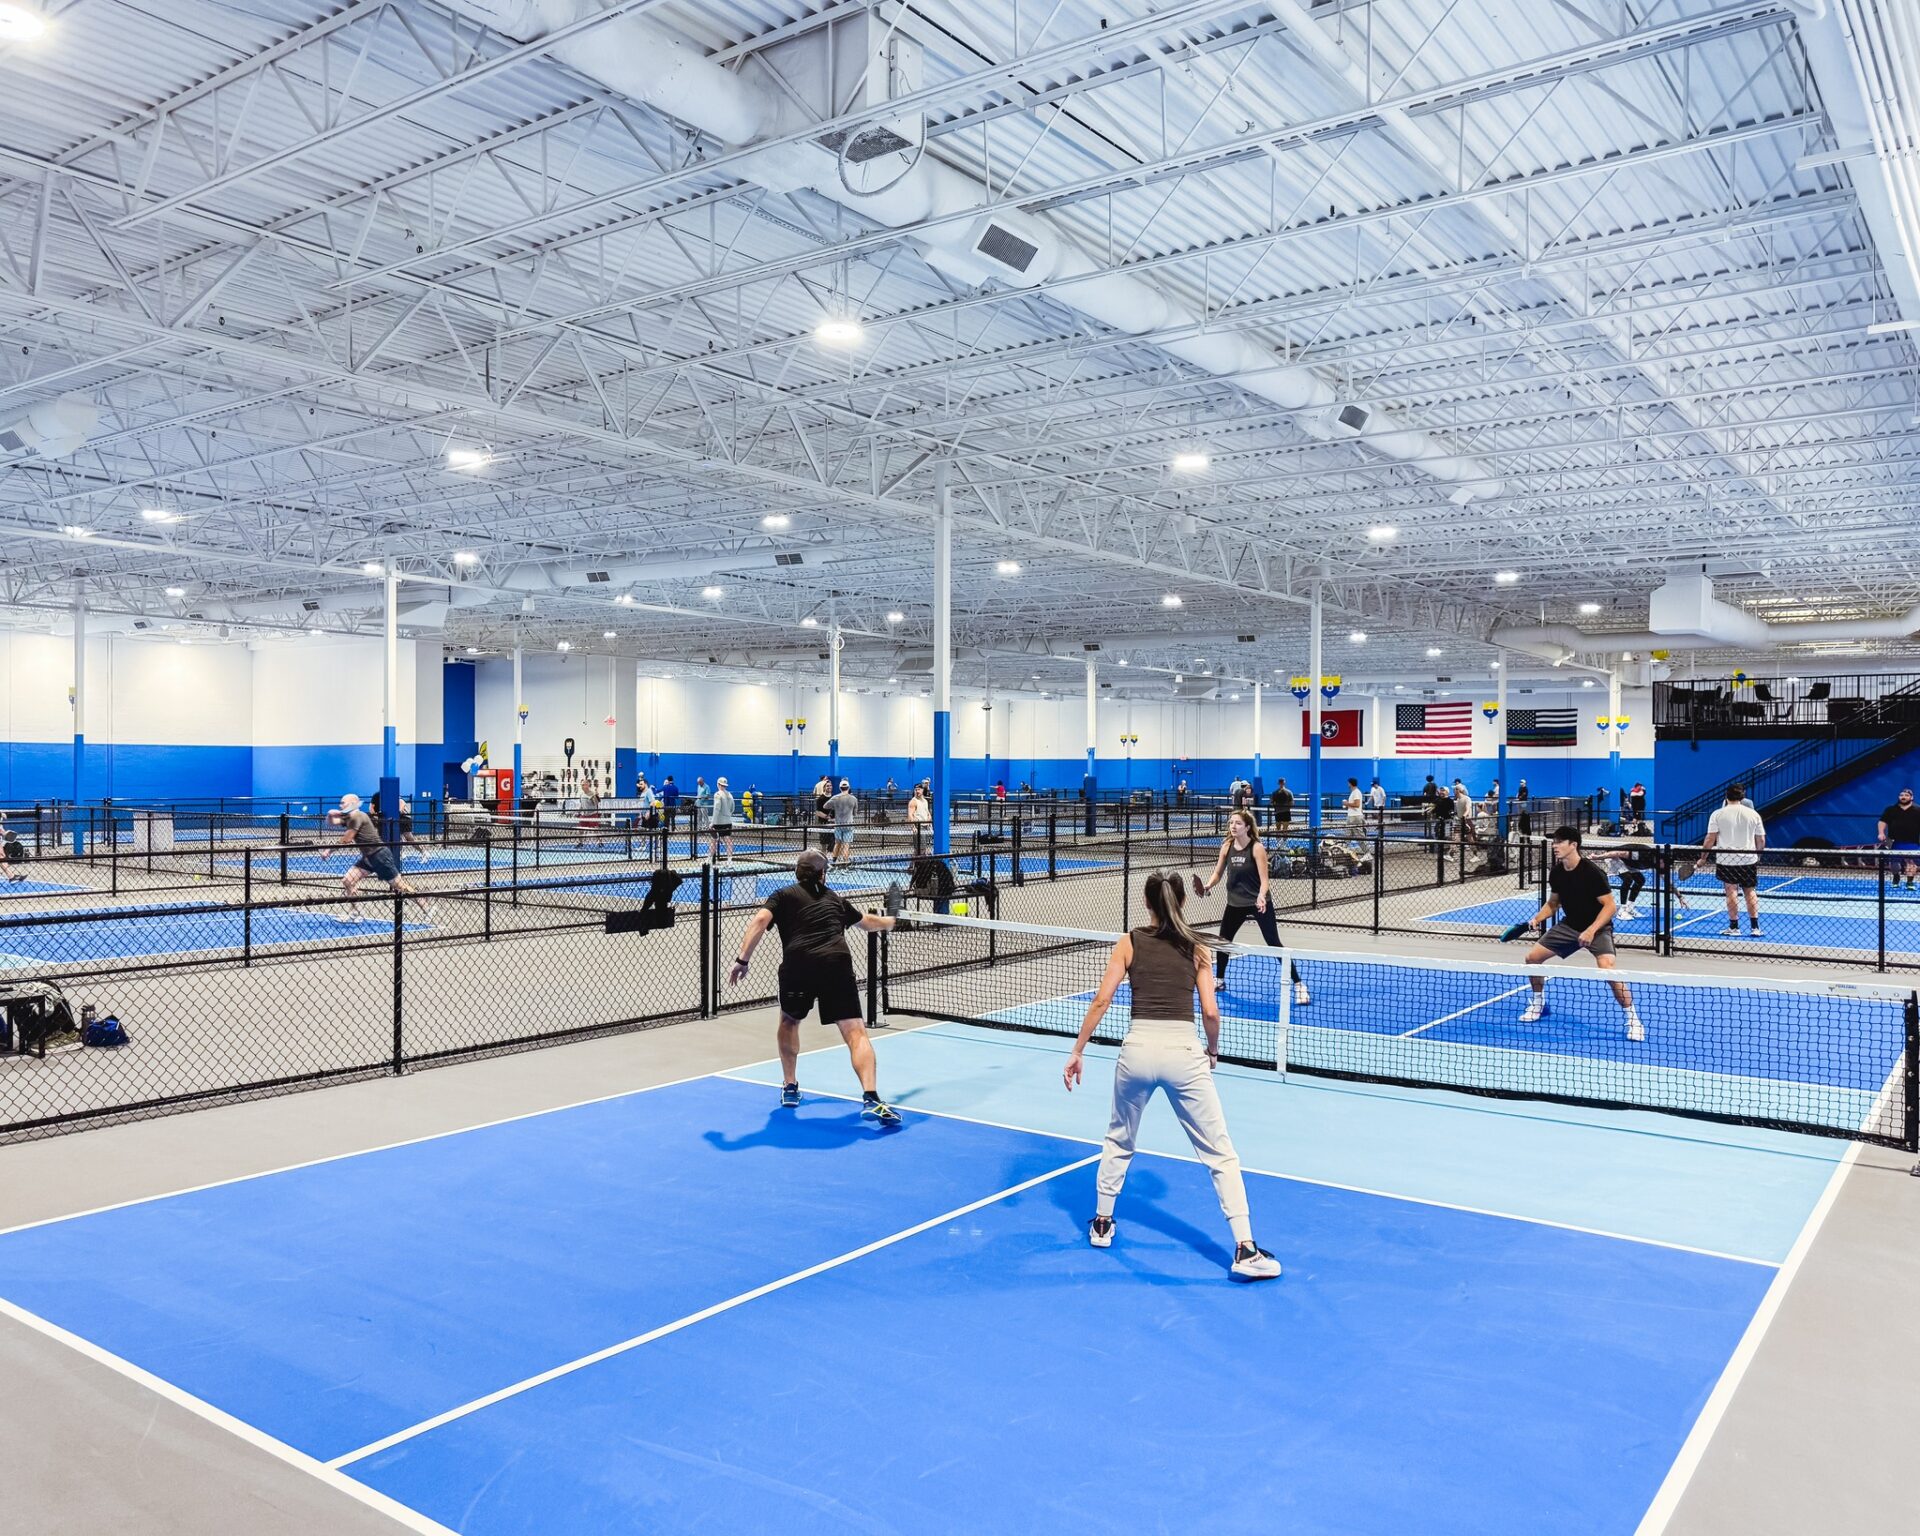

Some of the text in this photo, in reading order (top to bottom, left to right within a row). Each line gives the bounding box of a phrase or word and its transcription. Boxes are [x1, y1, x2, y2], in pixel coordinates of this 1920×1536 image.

[1293, 682, 1309, 693] 10
[1326, 681, 1334, 692] 8
[500, 777, 511, 791] G
